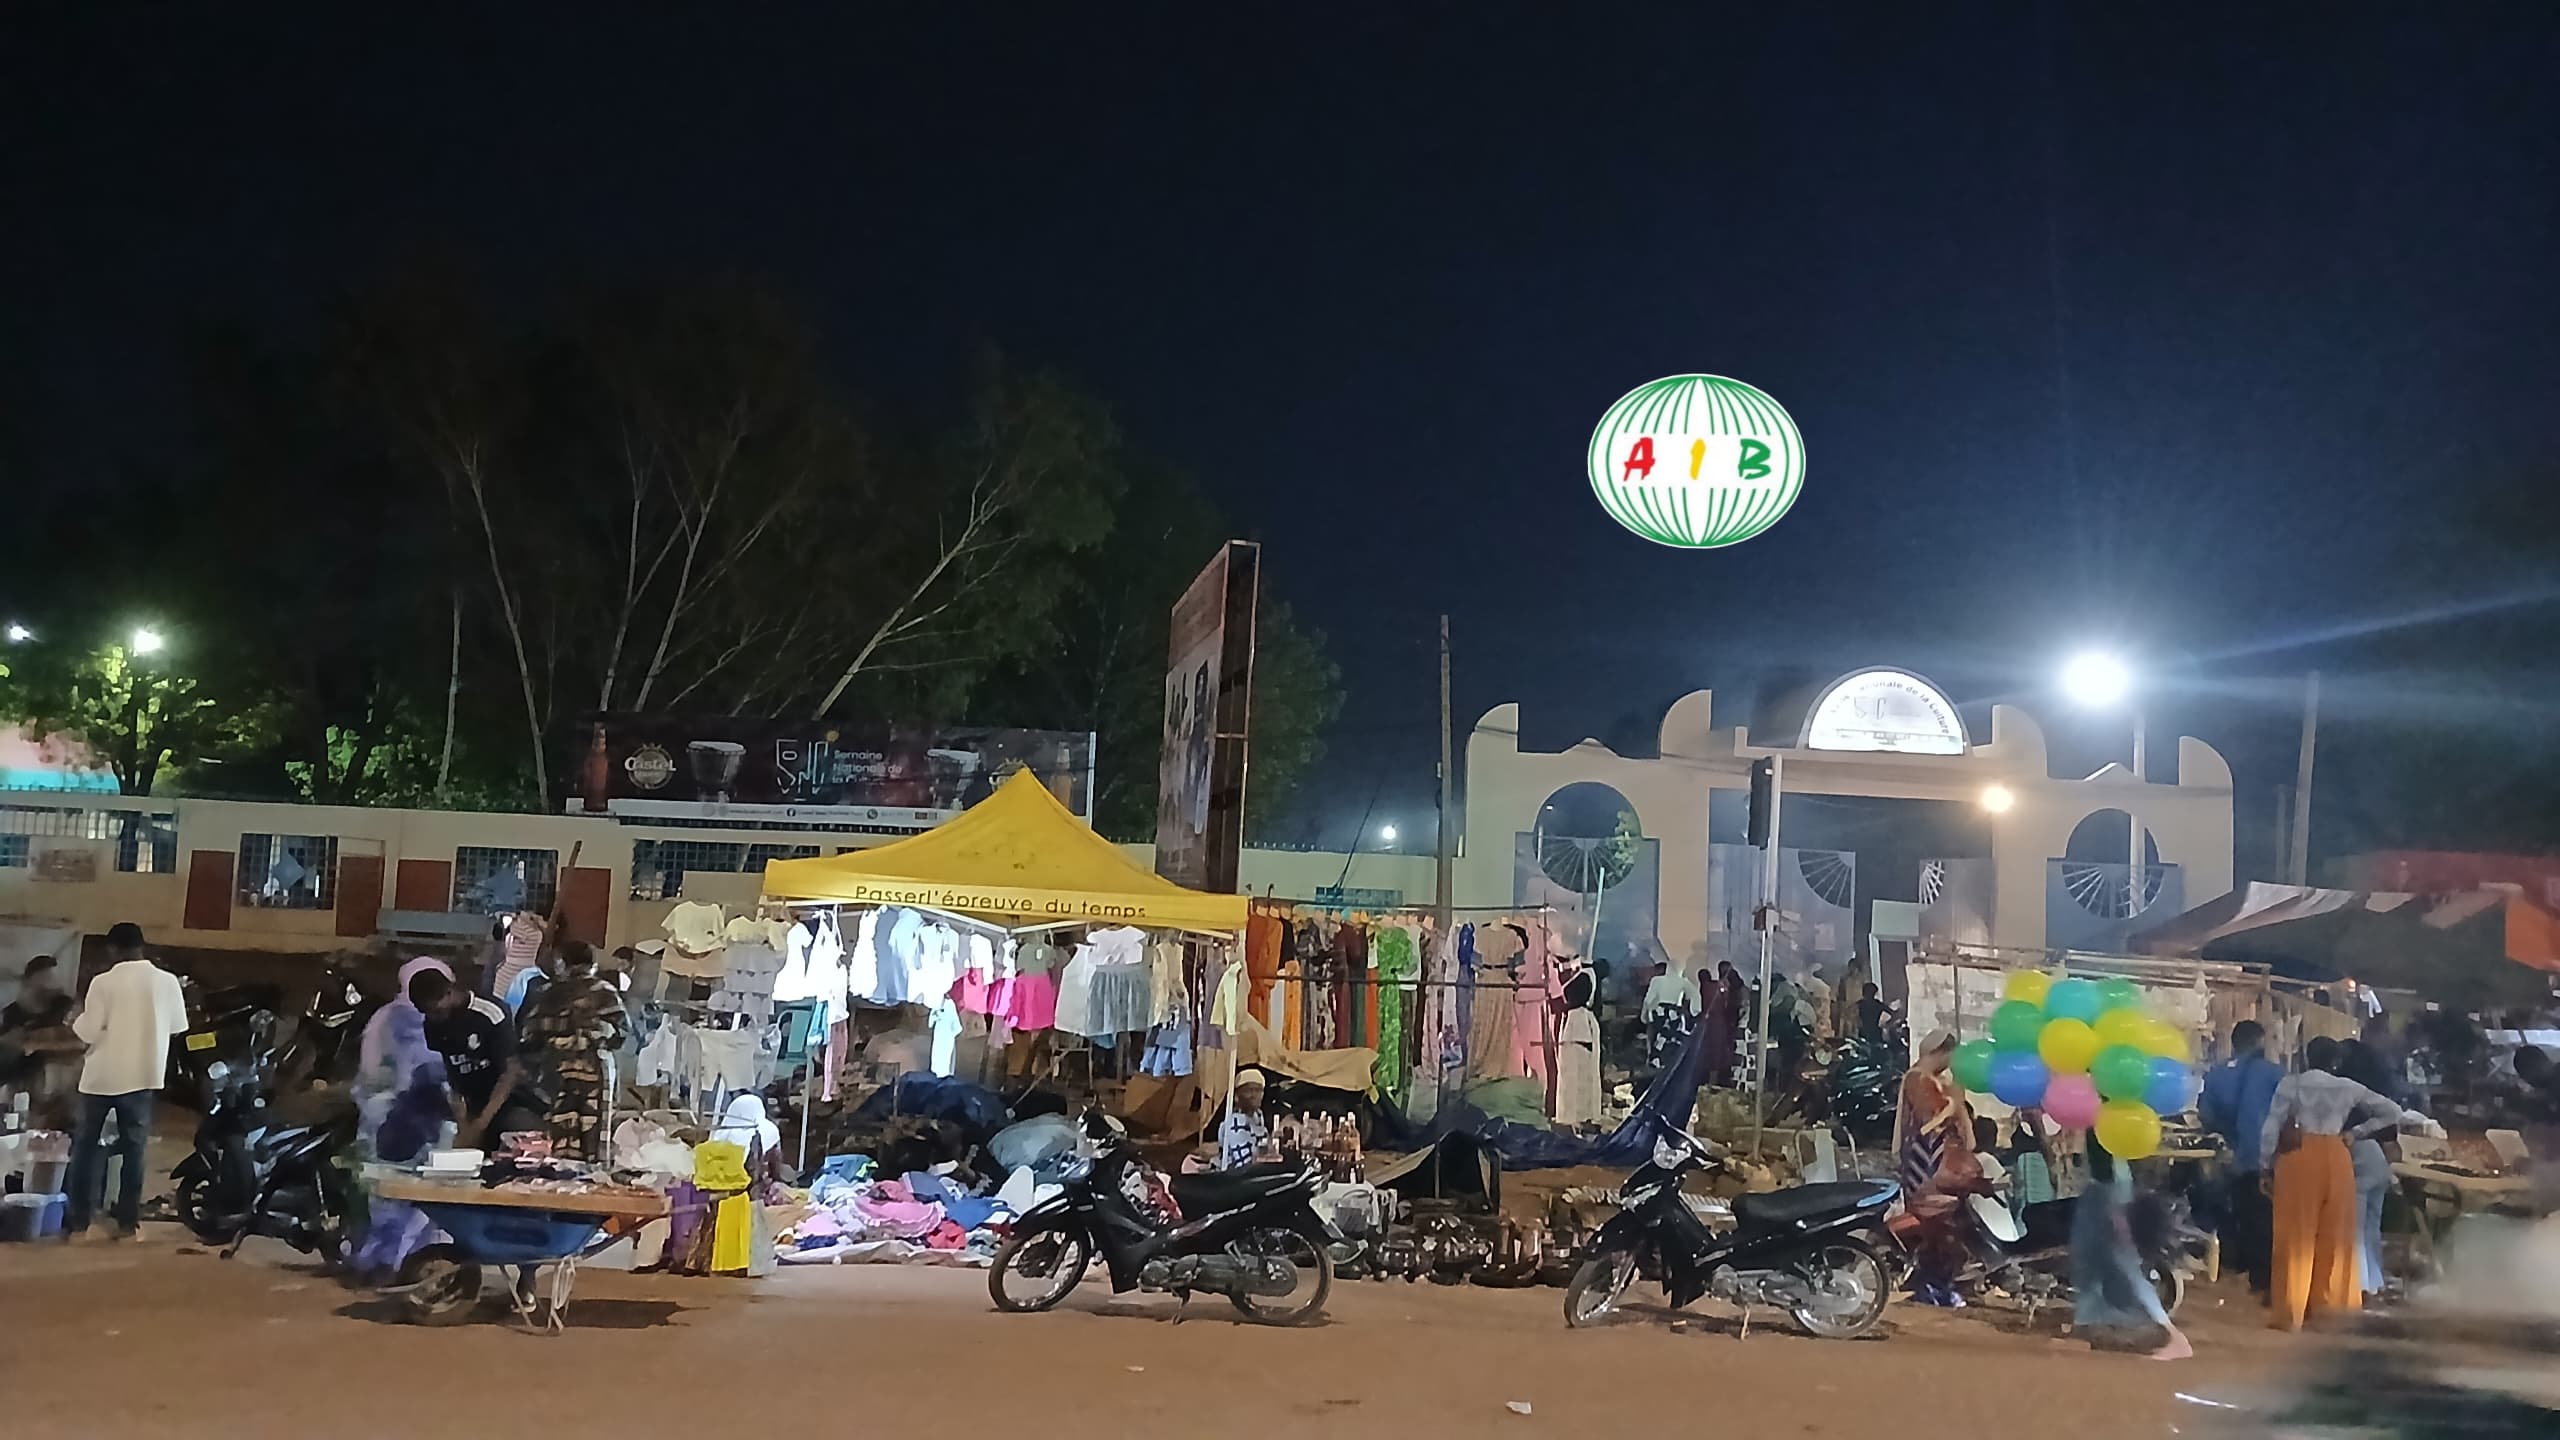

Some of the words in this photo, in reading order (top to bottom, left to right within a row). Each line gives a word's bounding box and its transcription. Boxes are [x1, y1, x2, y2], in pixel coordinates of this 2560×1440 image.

[834, 749, 883, 760] Semaine
[832, 763, 887, 774] Nationale
[887, 764, 903, 774] de
[1045, 898, 1072, 914] du
[1082, 901, 1147, 918] temps
